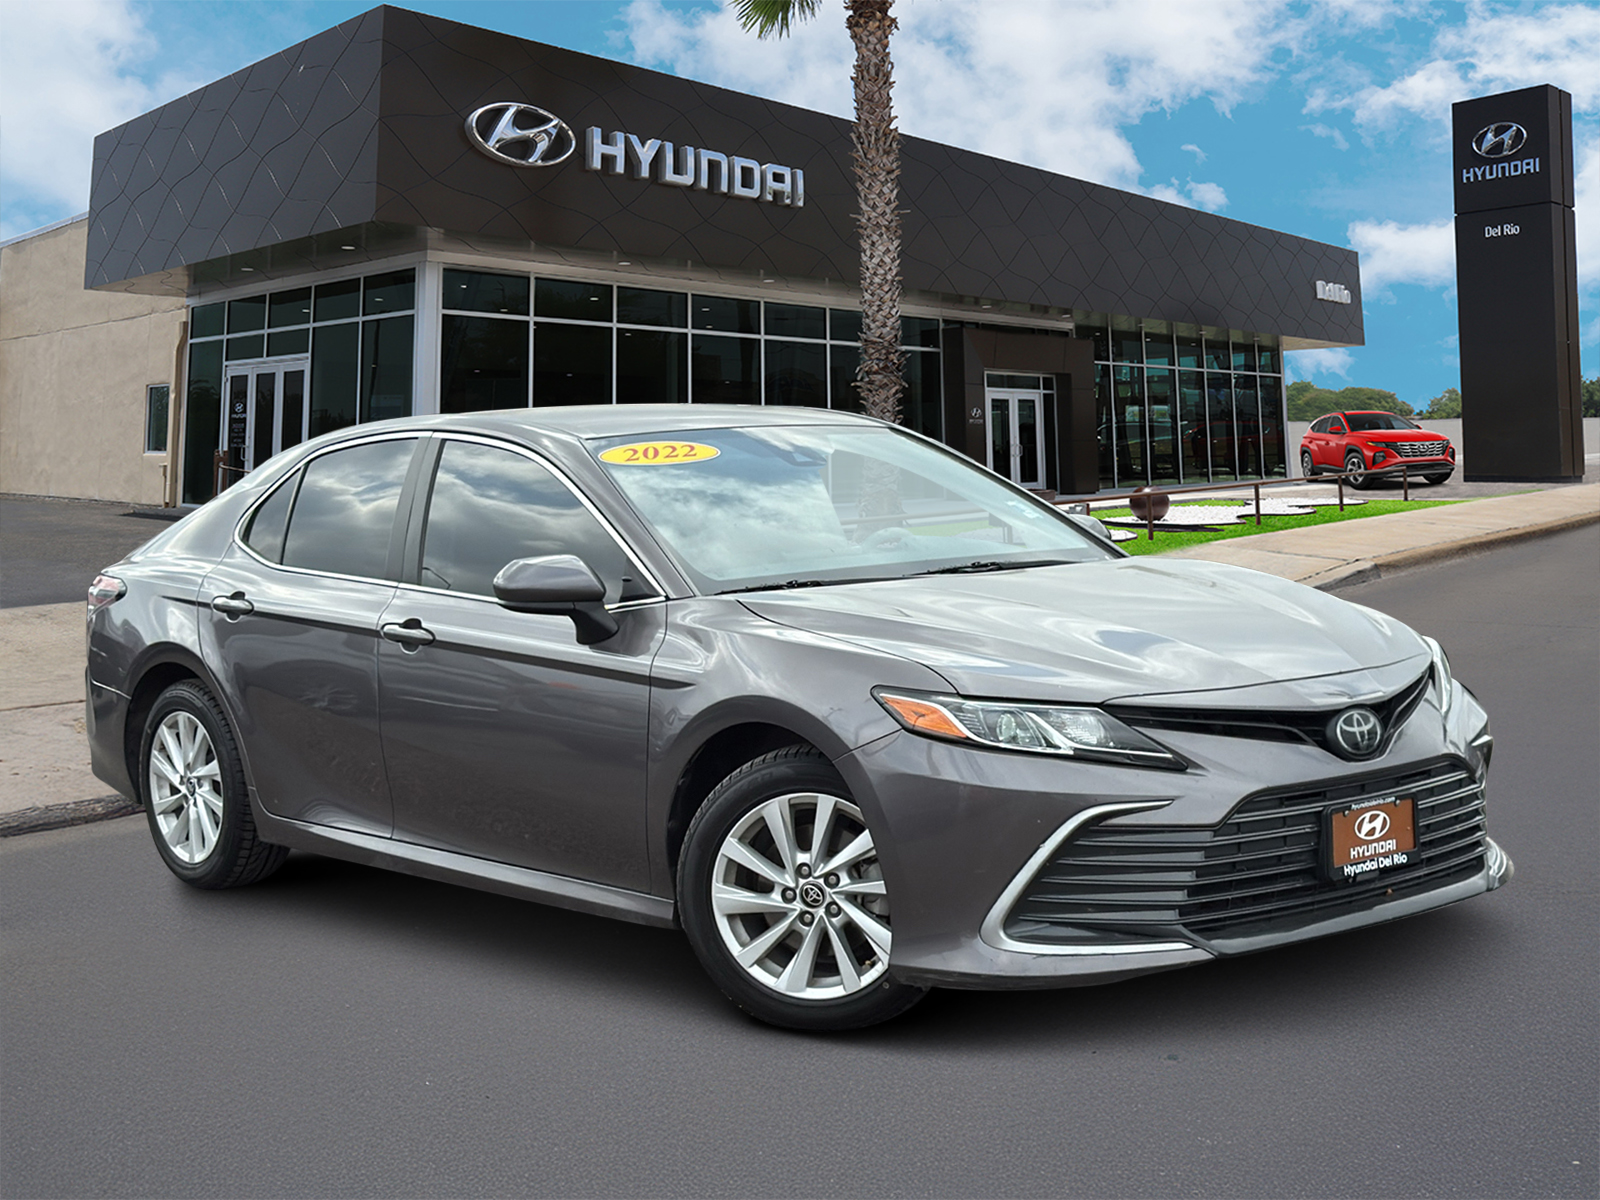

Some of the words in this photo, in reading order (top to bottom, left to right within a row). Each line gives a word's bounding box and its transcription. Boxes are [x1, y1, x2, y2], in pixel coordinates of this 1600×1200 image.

[585, 126, 804, 208] HYUNDAI
[1462, 157, 1540, 183] HYUNDAI
[1485, 225, 1501, 238] Del
[1503, 223, 1520, 235] Rio
[623, 444, 697, 462] 2022
[1350, 839, 1397, 859] HYUNDAI
[1343, 858, 1378, 877] Hyundai
[1378, 855, 1392, 869] Del
[1393, 852, 1408, 865] Rio
